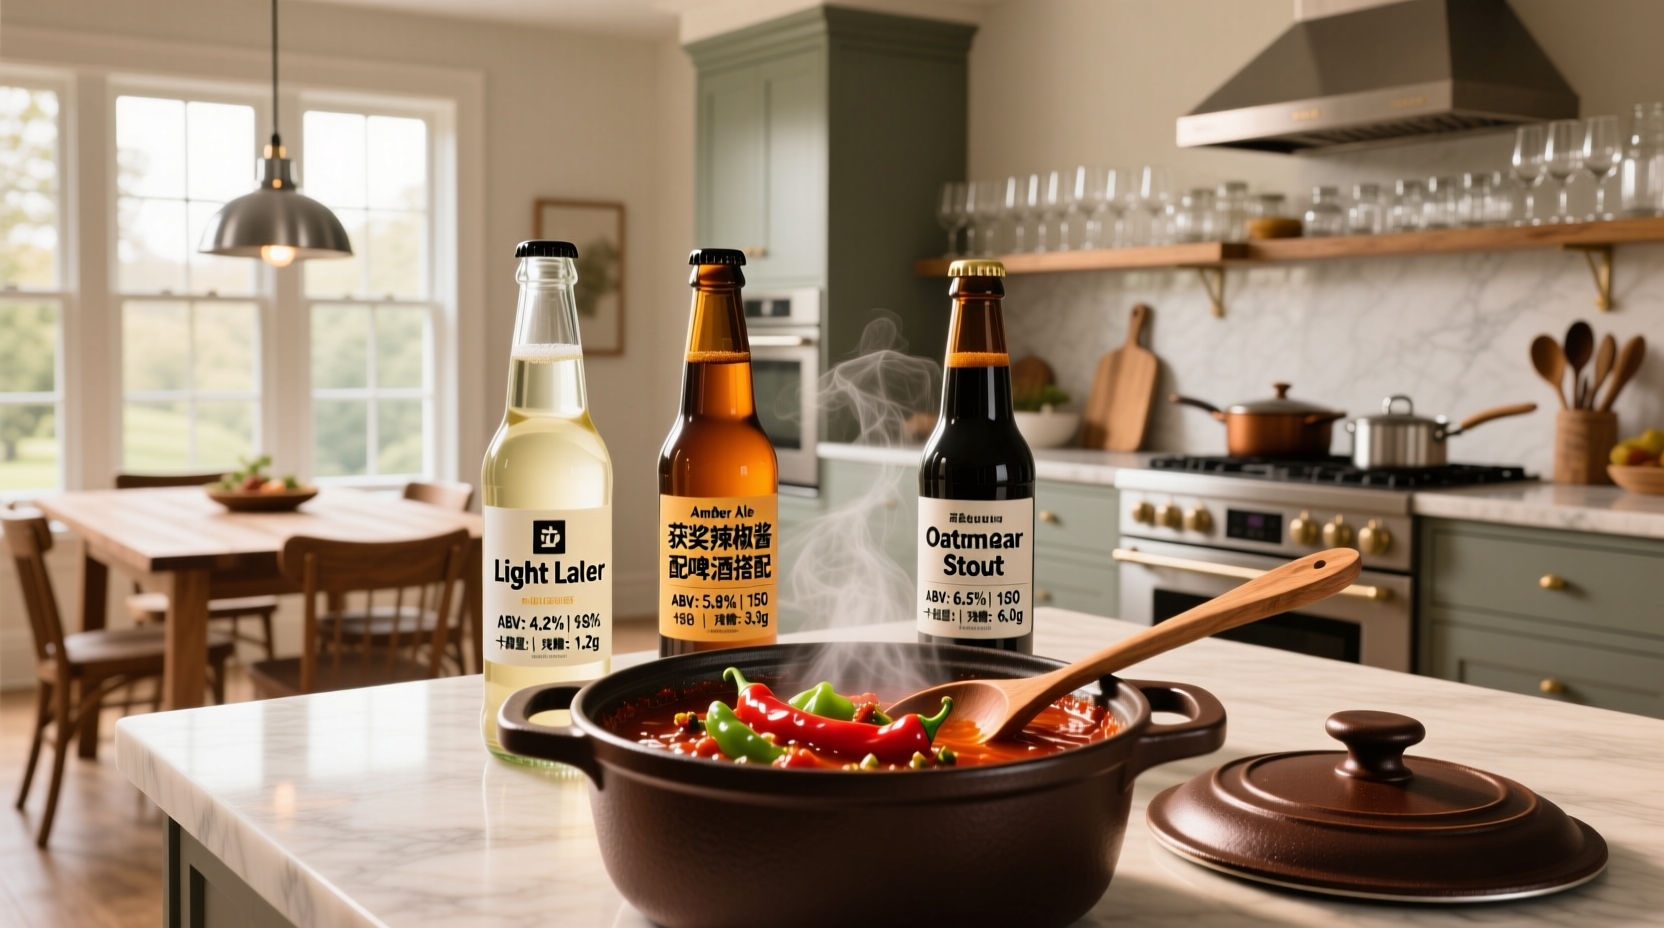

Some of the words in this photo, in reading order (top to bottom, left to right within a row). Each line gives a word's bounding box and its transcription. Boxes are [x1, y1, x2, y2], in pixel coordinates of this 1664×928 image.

[735, 504, 755, 519] Ale
[667, 521, 772, 551] 获奖辣椒酱
[494, 558, 549, 590] Light
[554, 560, 606, 584] Laler
[668, 553, 772, 582] 配啤酒搭配
[943, 553, 1005, 577] Stout
[671, 593, 699, 609] ABV:
[925, 589, 950, 605] ABV:
[953, 590, 987, 606] 6.5%
[497, 614, 526, 630] ABV:
[529, 614, 564, 631] 4.2%
[575, 634, 600, 652] 1.2g
